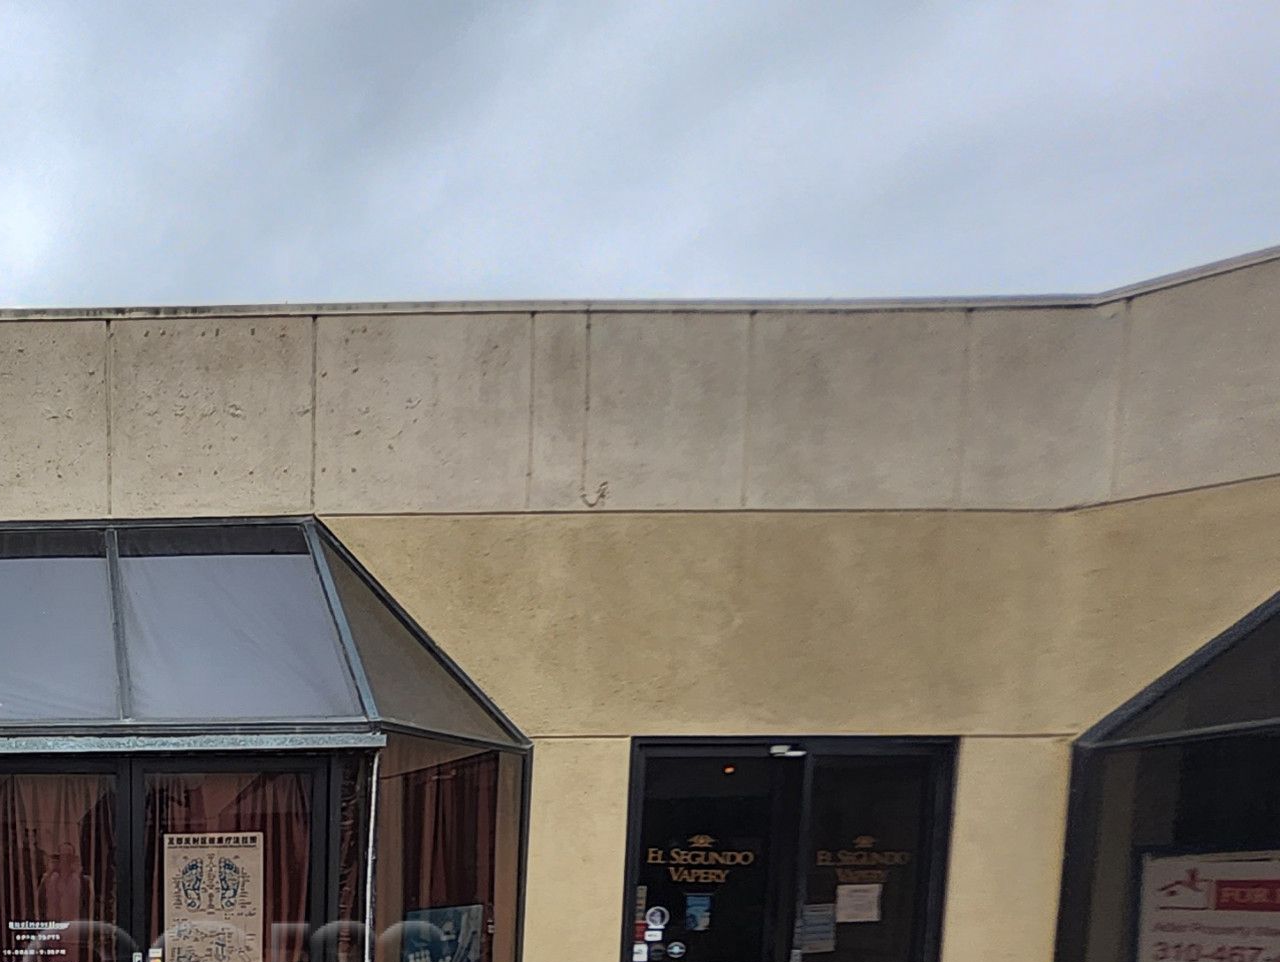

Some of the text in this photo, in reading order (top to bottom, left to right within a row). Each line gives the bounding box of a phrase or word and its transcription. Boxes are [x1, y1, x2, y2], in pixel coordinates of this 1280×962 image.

[647, 848, 754, 865] EL SEGUNDO
[668, 867, 729, 882] VAPERY
